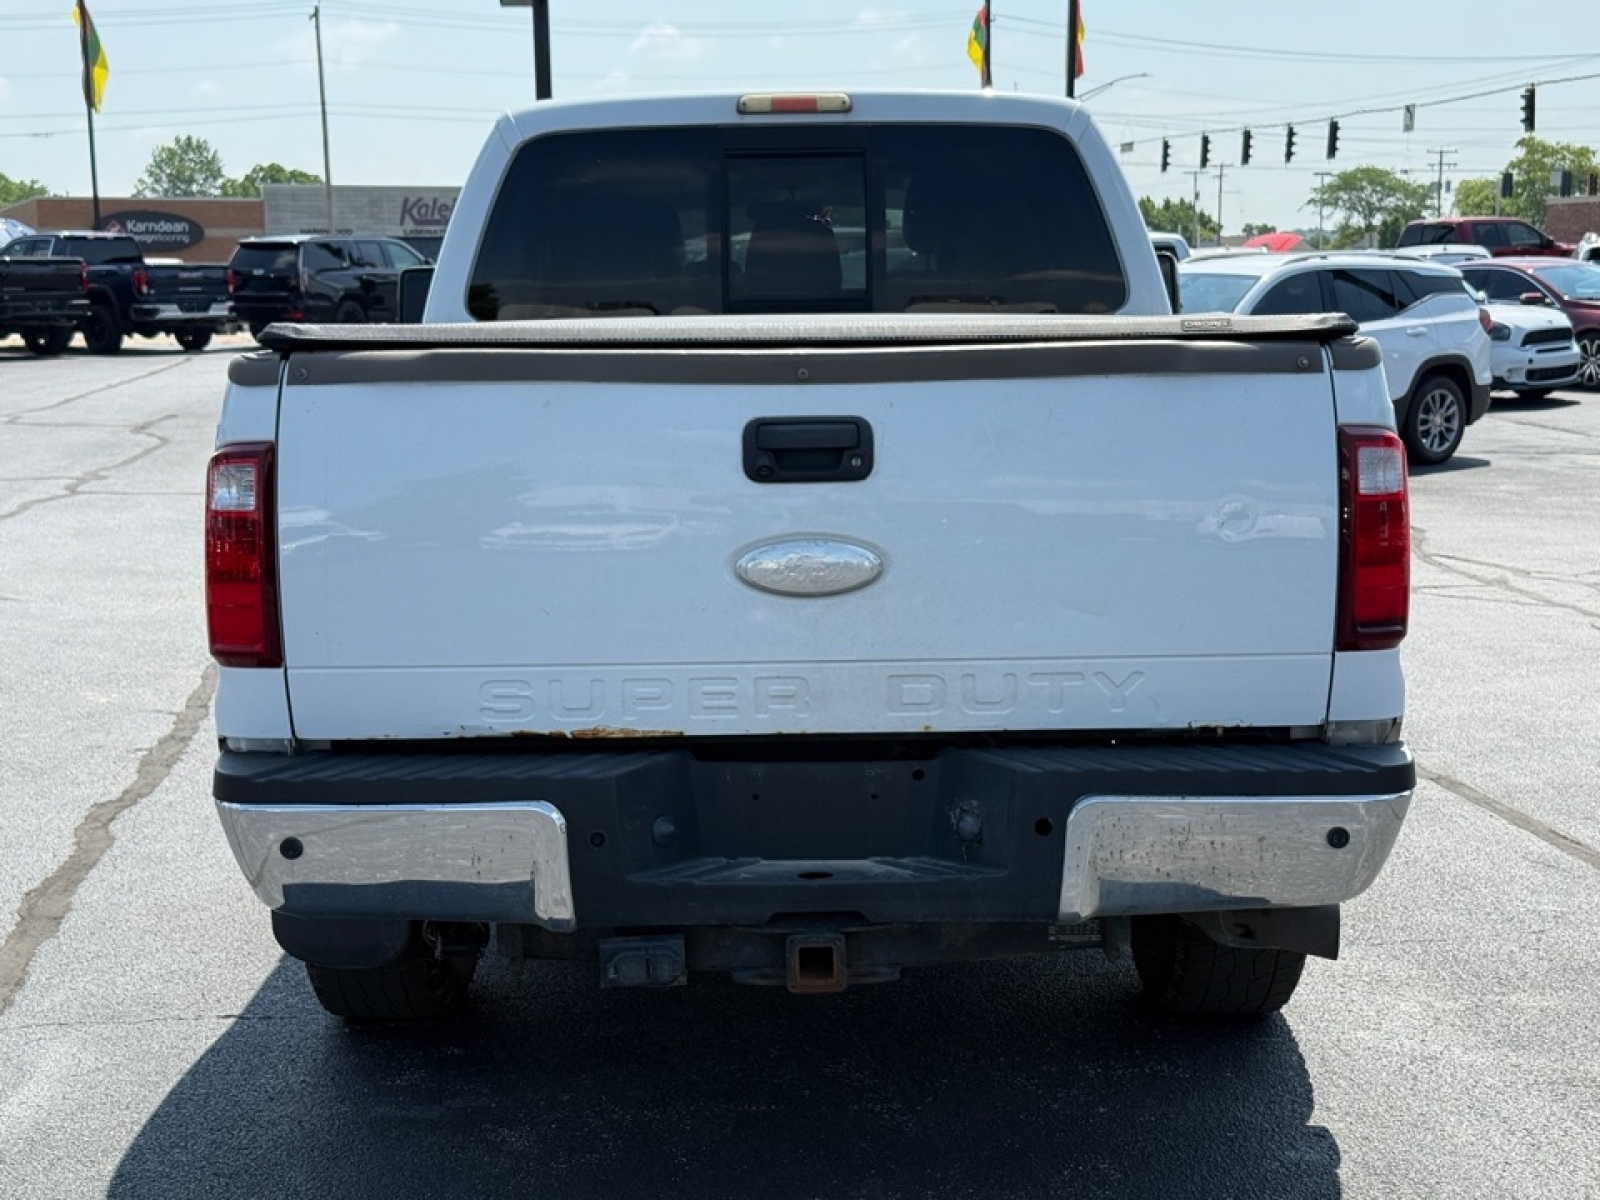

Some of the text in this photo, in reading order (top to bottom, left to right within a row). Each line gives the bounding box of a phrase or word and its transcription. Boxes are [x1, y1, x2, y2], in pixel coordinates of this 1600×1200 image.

[126, 219, 189, 233] Karndean
[479, 669, 1146, 723] SUPER DUTY
